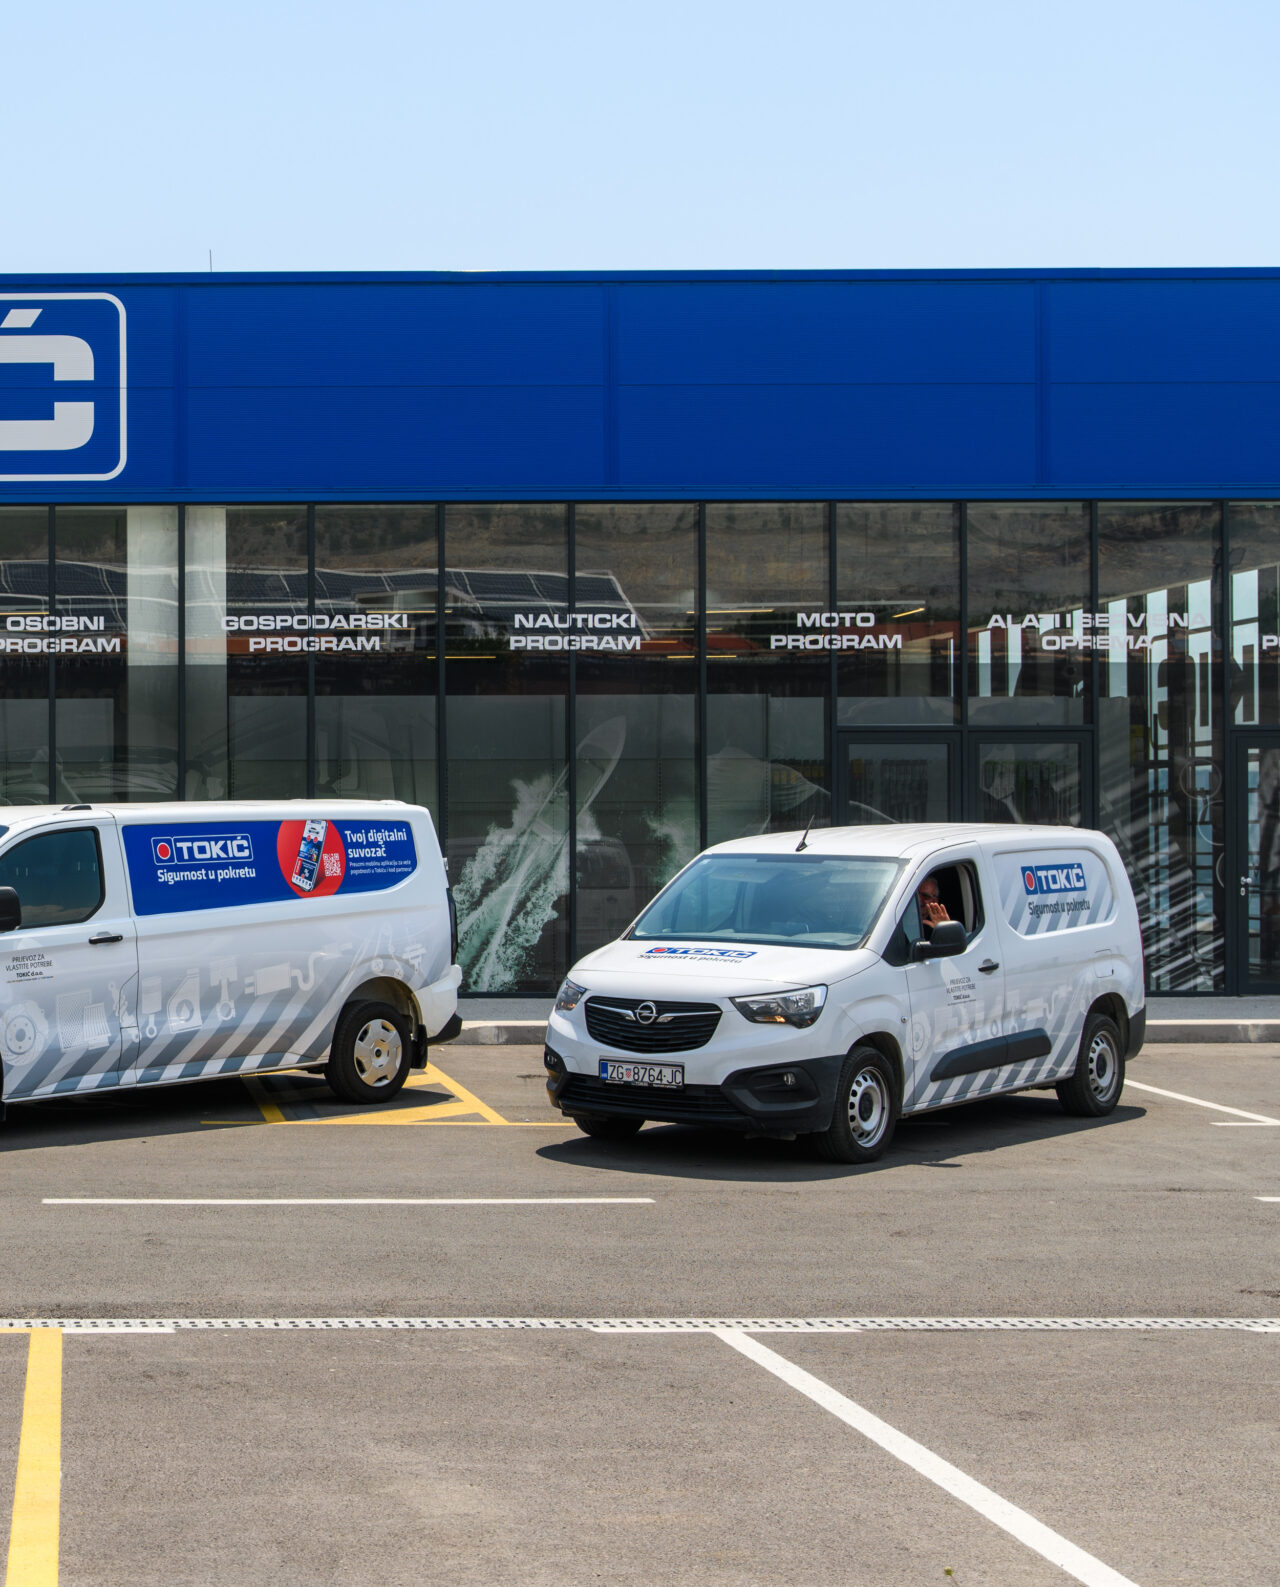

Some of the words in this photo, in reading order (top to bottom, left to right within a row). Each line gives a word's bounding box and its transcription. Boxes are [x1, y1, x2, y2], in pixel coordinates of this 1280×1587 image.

[6, 615, 105, 632] OSOBNI
[221, 613, 408, 631] GOSPODARSKI
[514, 613, 636, 629] NAUTICKI
[796, 612, 875, 628] MOTO
[249, 636, 381, 652] PROGRAM
[509, 635, 641, 651] PROGRAM
[770, 634, 903, 650] PROGRAM
[1041, 634, 1153, 651] OPREMA
[344, 829, 367, 845] Tvoj
[367, 828, 407, 845] digitalni
[176, 836, 250, 860] TOKIĆ
[348, 844, 387, 858] suvozač
[157, 868, 207, 885] Sigurnost
[208, 870, 216, 880] u
[217, 866, 256, 882] pokretu
[1037, 864, 1085, 890] TOKIĆ
[1027, 901, 1061, 919] Sigurnost
[1066, 897, 1091, 916] pokretu
[609, 1064, 624, 1080] ZG
